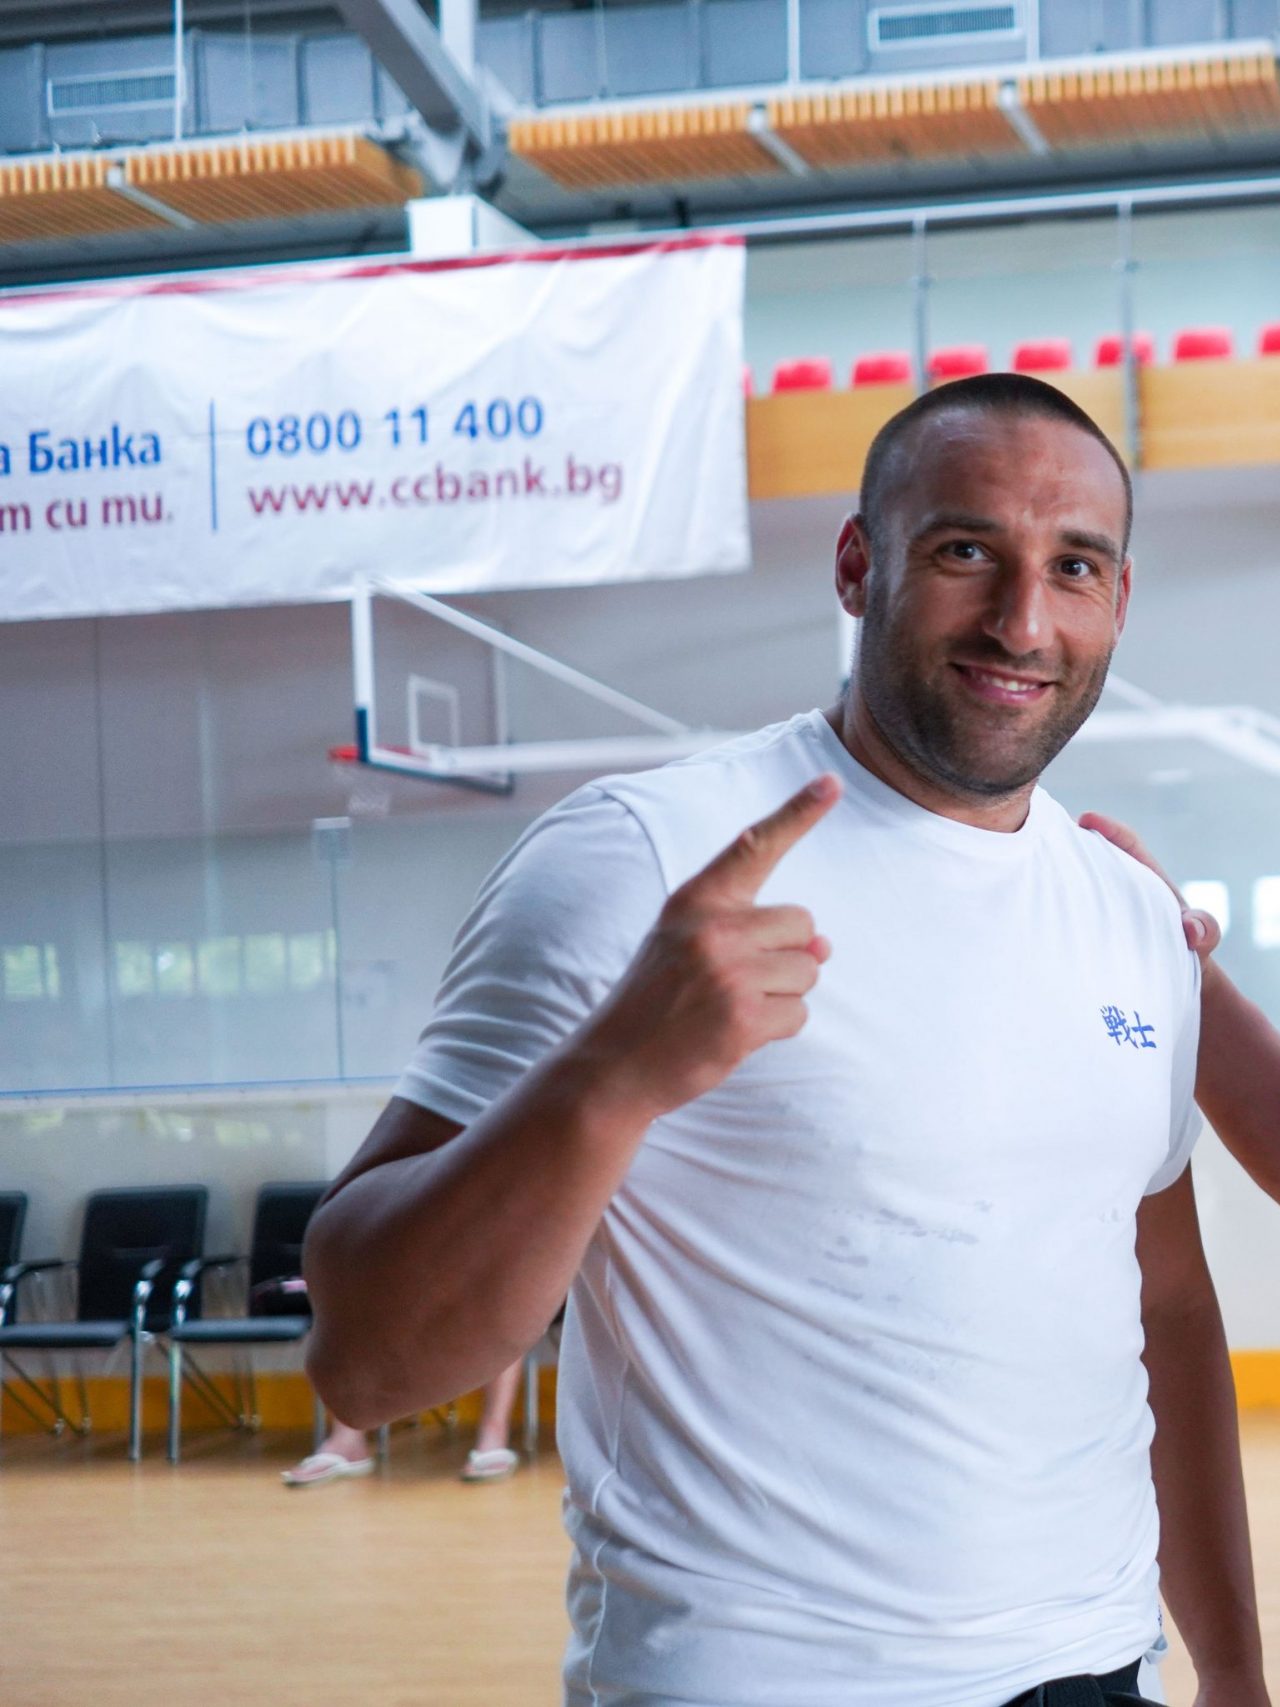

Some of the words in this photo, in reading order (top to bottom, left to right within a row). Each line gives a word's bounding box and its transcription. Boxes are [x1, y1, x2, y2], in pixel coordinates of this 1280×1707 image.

[29, 422, 161, 473] Банка
[247, 410, 362, 456] 0800
[384, 405, 429, 446] 11
[452, 396, 543, 440] 400
[249, 455, 624, 514] www.ccbank.bg
[1100, 1005, 1157, 1049] 戦士
